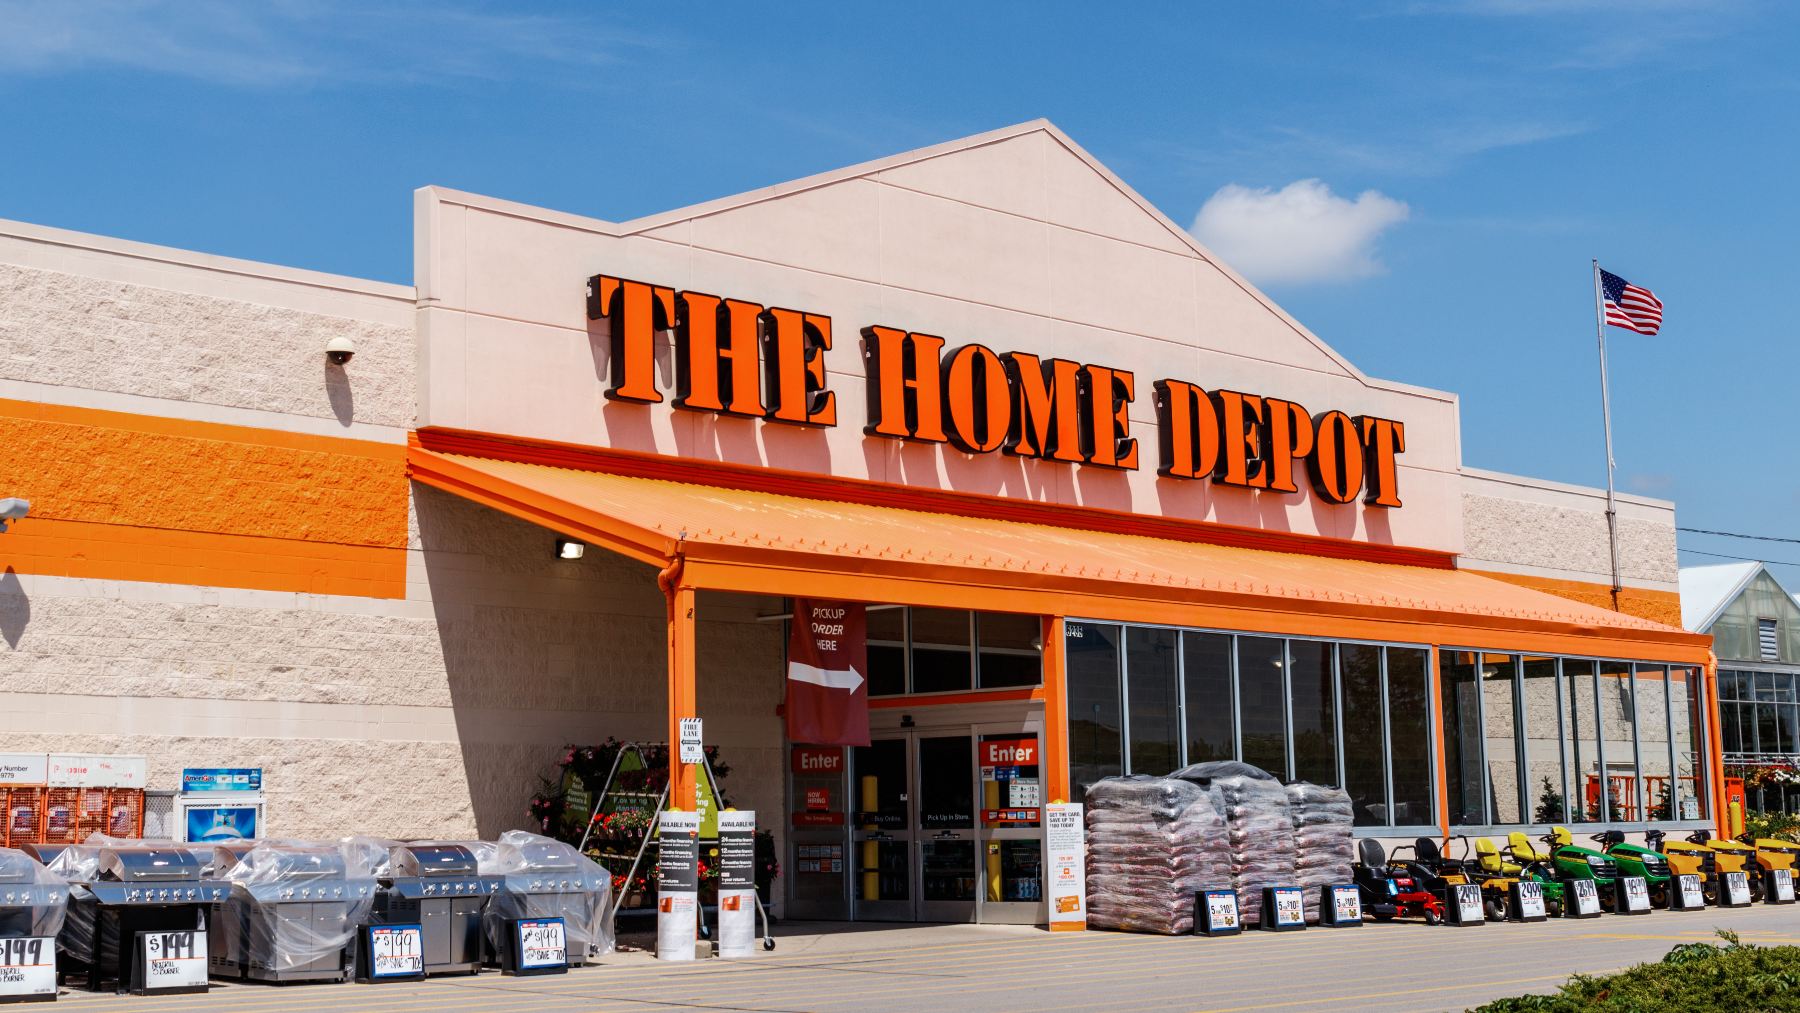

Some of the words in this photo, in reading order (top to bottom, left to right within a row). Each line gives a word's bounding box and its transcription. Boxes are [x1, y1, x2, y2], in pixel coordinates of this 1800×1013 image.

[587, 274, 837, 428] THE
[860, 324, 1139, 471] HOME
[1153, 378, 1405, 508] DEPOT
[812, 607, 845, 619] PICKUP
[811, 622, 844, 635] ORDER
[816, 639, 837, 651] HERE
[989, 744, 1033, 762] Enter
[801, 752, 840, 769] Enter
[4, 764, 28, 772] Number
[940, 814, 948, 822] Up
[534, 928, 558, 948] $199
[149, 932, 195, 959] $199
[383, 933, 412, 957] $199
[4, 973, 25, 982] BURNER
[159, 966, 180, 976] BURNER
